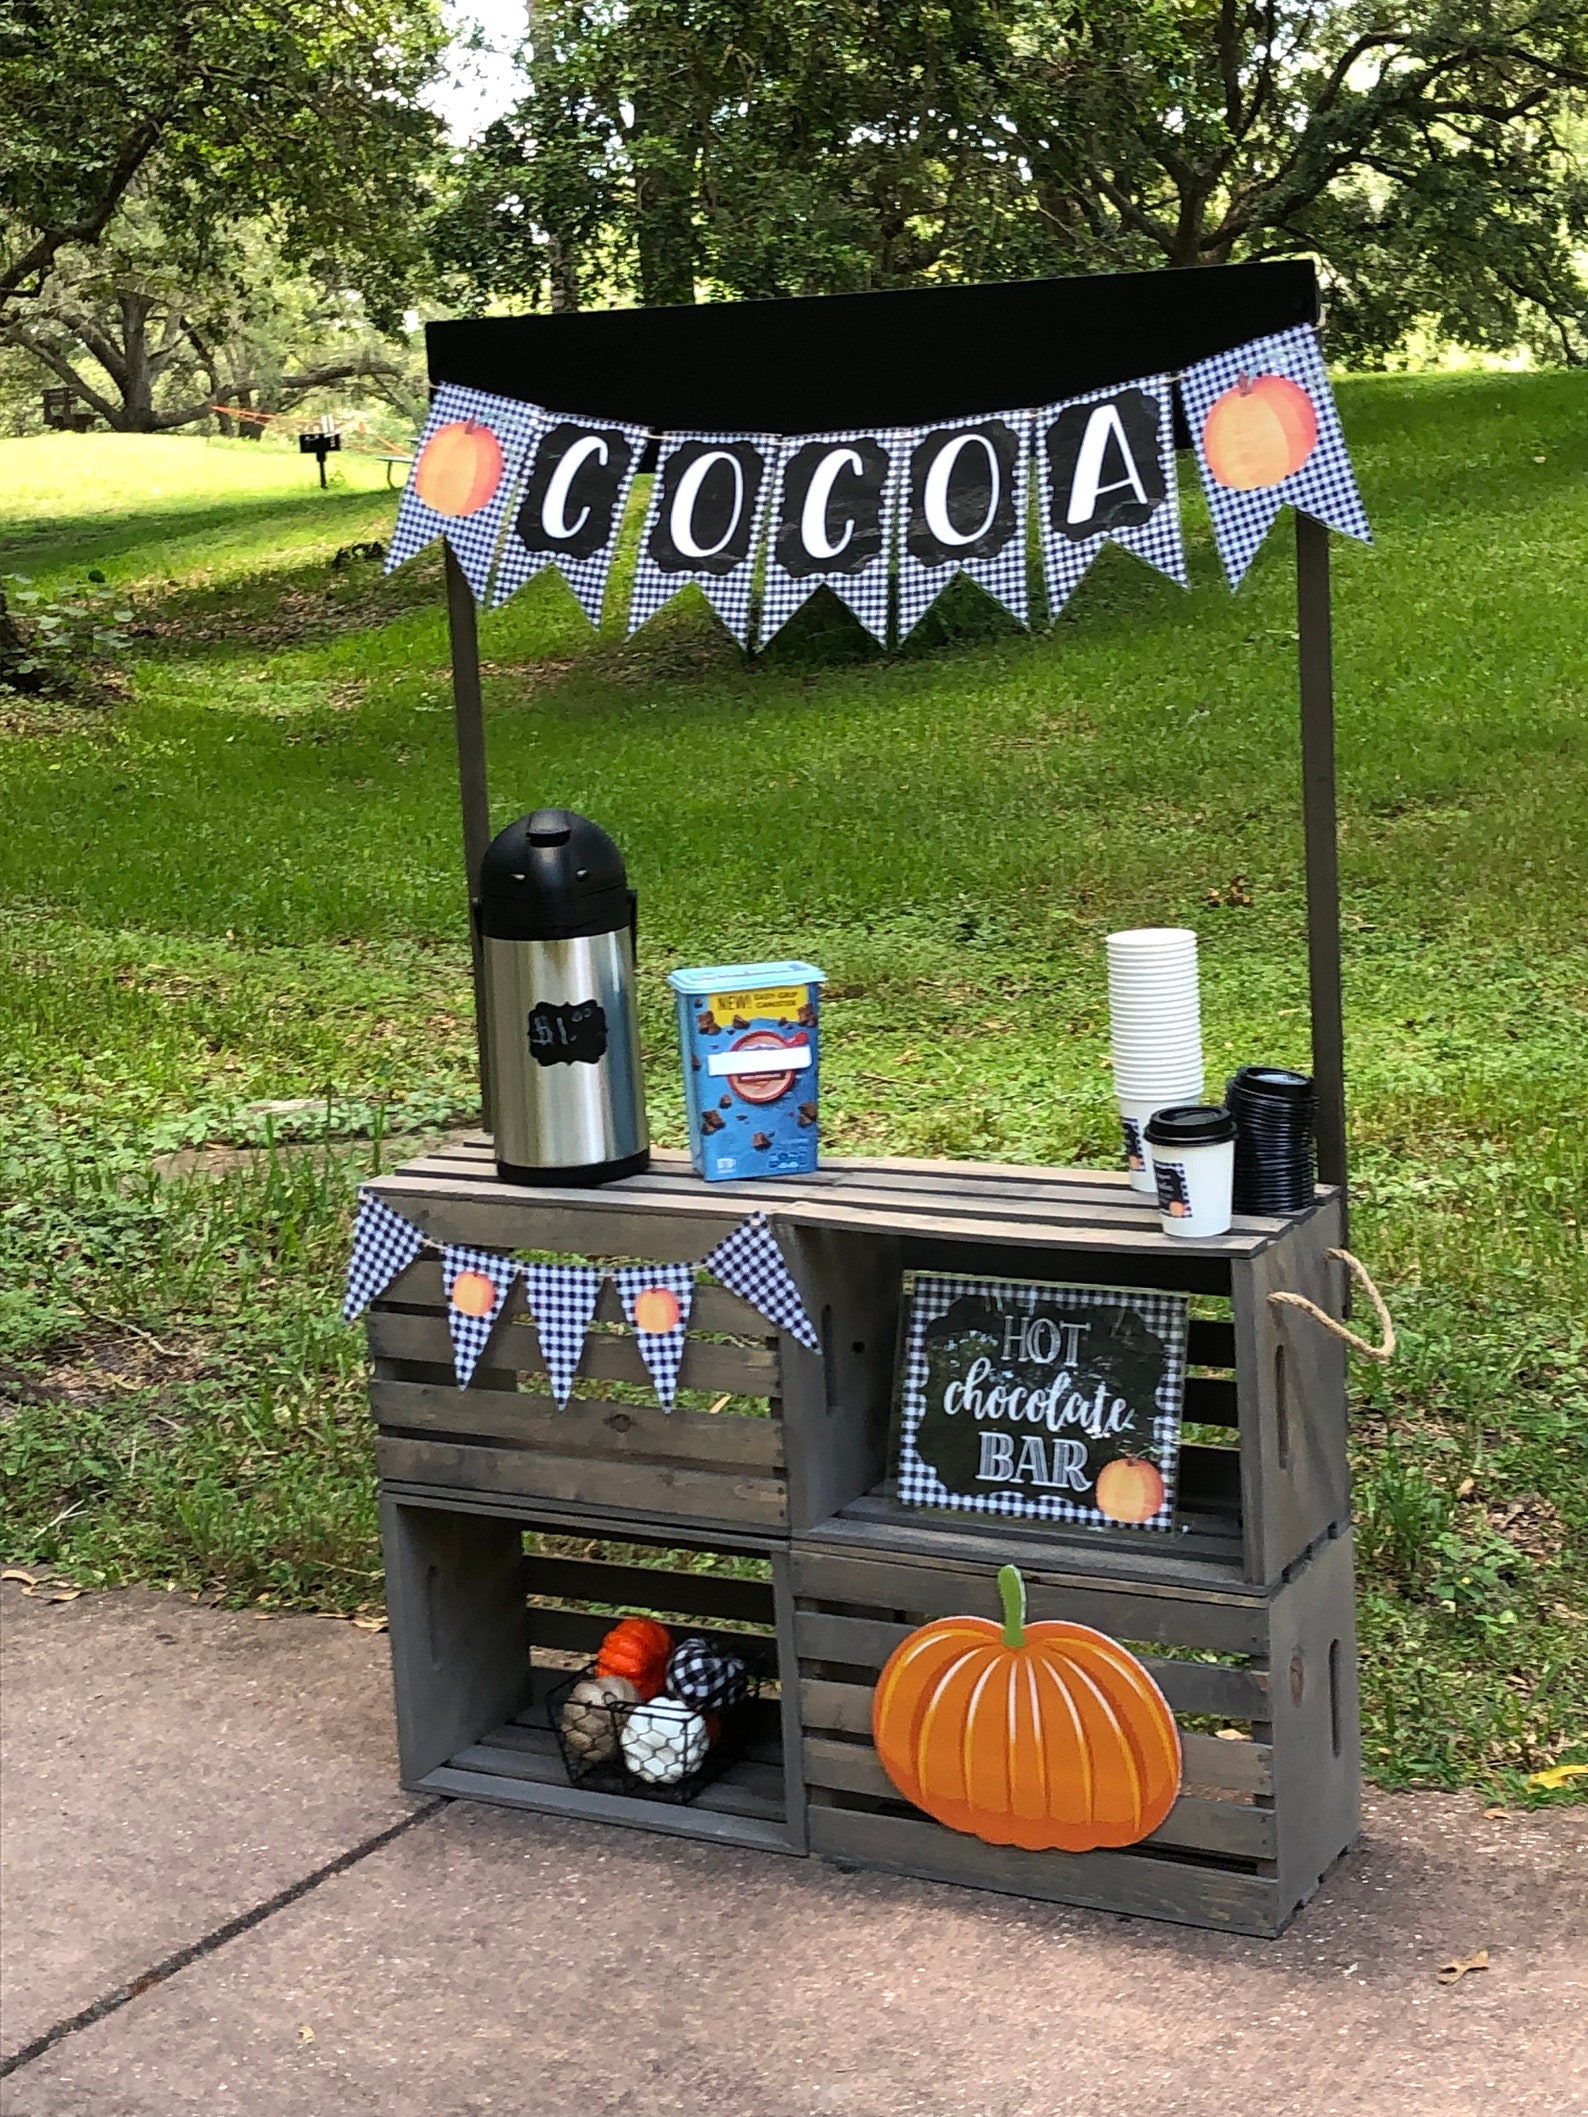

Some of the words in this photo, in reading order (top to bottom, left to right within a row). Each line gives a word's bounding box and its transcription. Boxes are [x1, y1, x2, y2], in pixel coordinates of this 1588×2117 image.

[540, 404, 1147, 558] COCOA
[1000, 1315, 1091, 1367] HOT
[943, 1357, 1136, 1436] chocolate
[975, 1431, 1093, 1492] BAR
